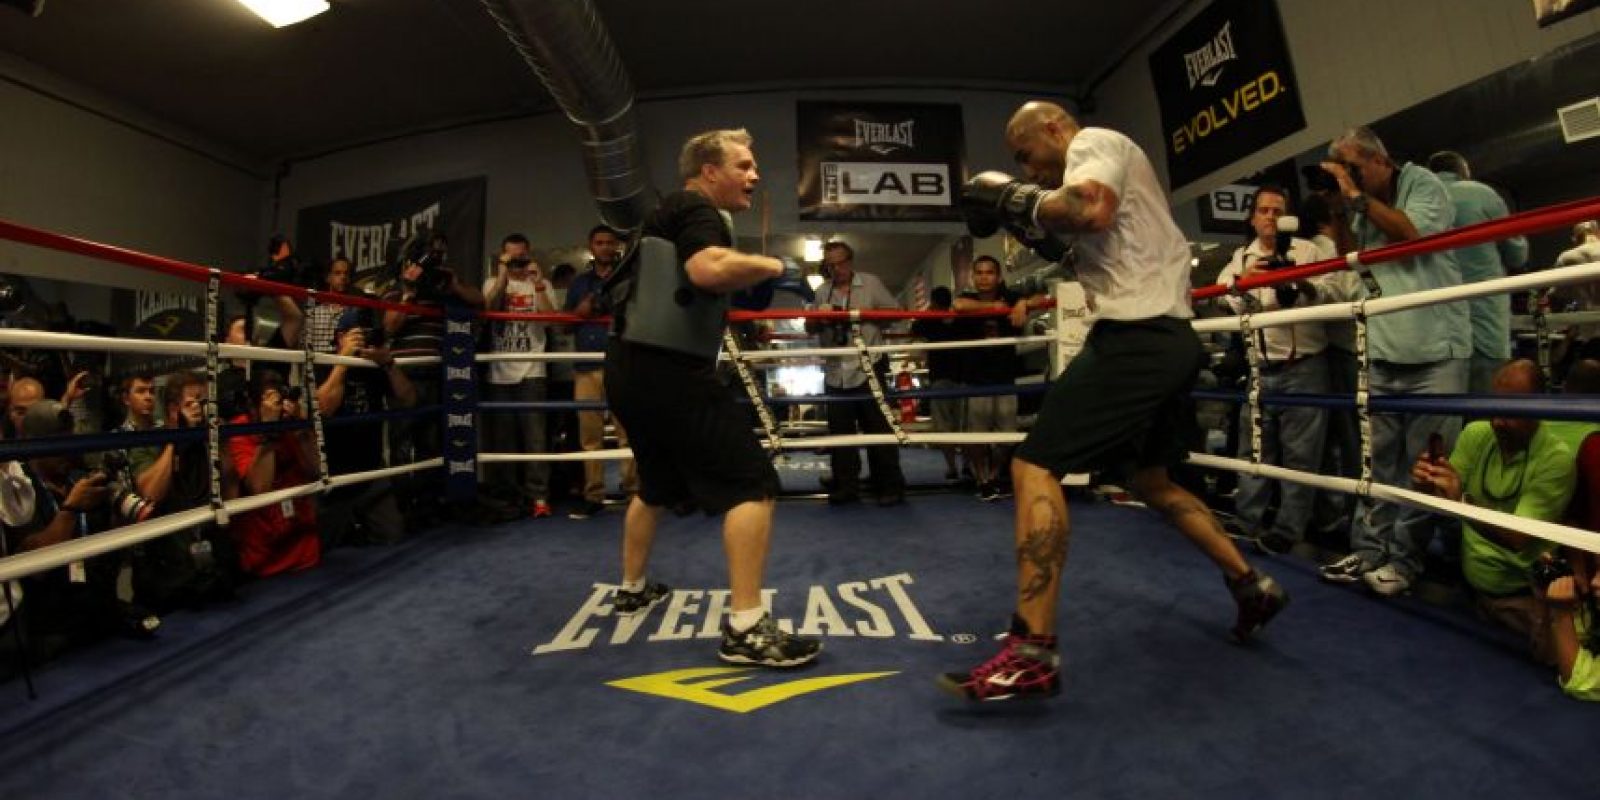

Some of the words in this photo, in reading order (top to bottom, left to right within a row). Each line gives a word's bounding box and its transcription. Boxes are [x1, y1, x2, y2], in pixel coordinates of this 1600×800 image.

[1184, 19, 1238, 91] EVERLAST
[1172, 70, 1286, 155] EVOLVED.
[854, 118, 915, 149] EVERLAST
[823, 164, 838, 201] THE
[842, 172, 944, 195] LAB
